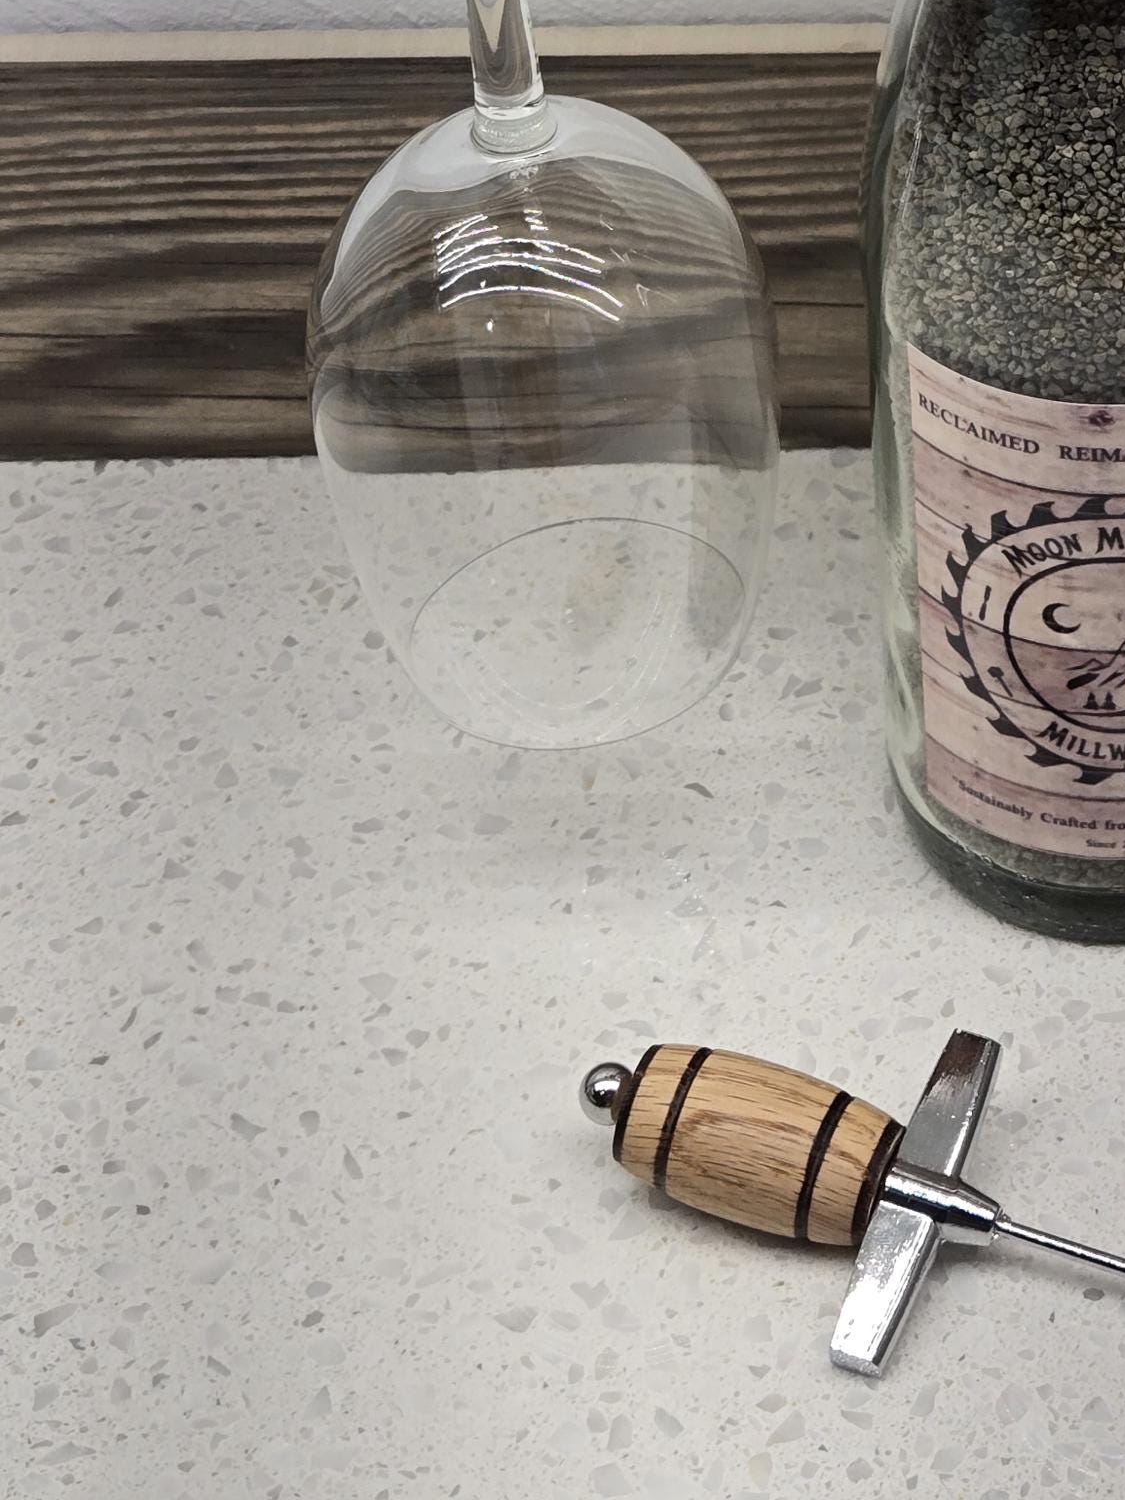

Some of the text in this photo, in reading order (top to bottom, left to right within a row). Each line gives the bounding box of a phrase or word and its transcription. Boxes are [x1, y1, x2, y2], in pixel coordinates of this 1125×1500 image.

[918, 392, 1040, 454] RECLAIMED
[1001, 532, 1082, 578] MOON
[1040, 812, 1098, 830] Crafted
